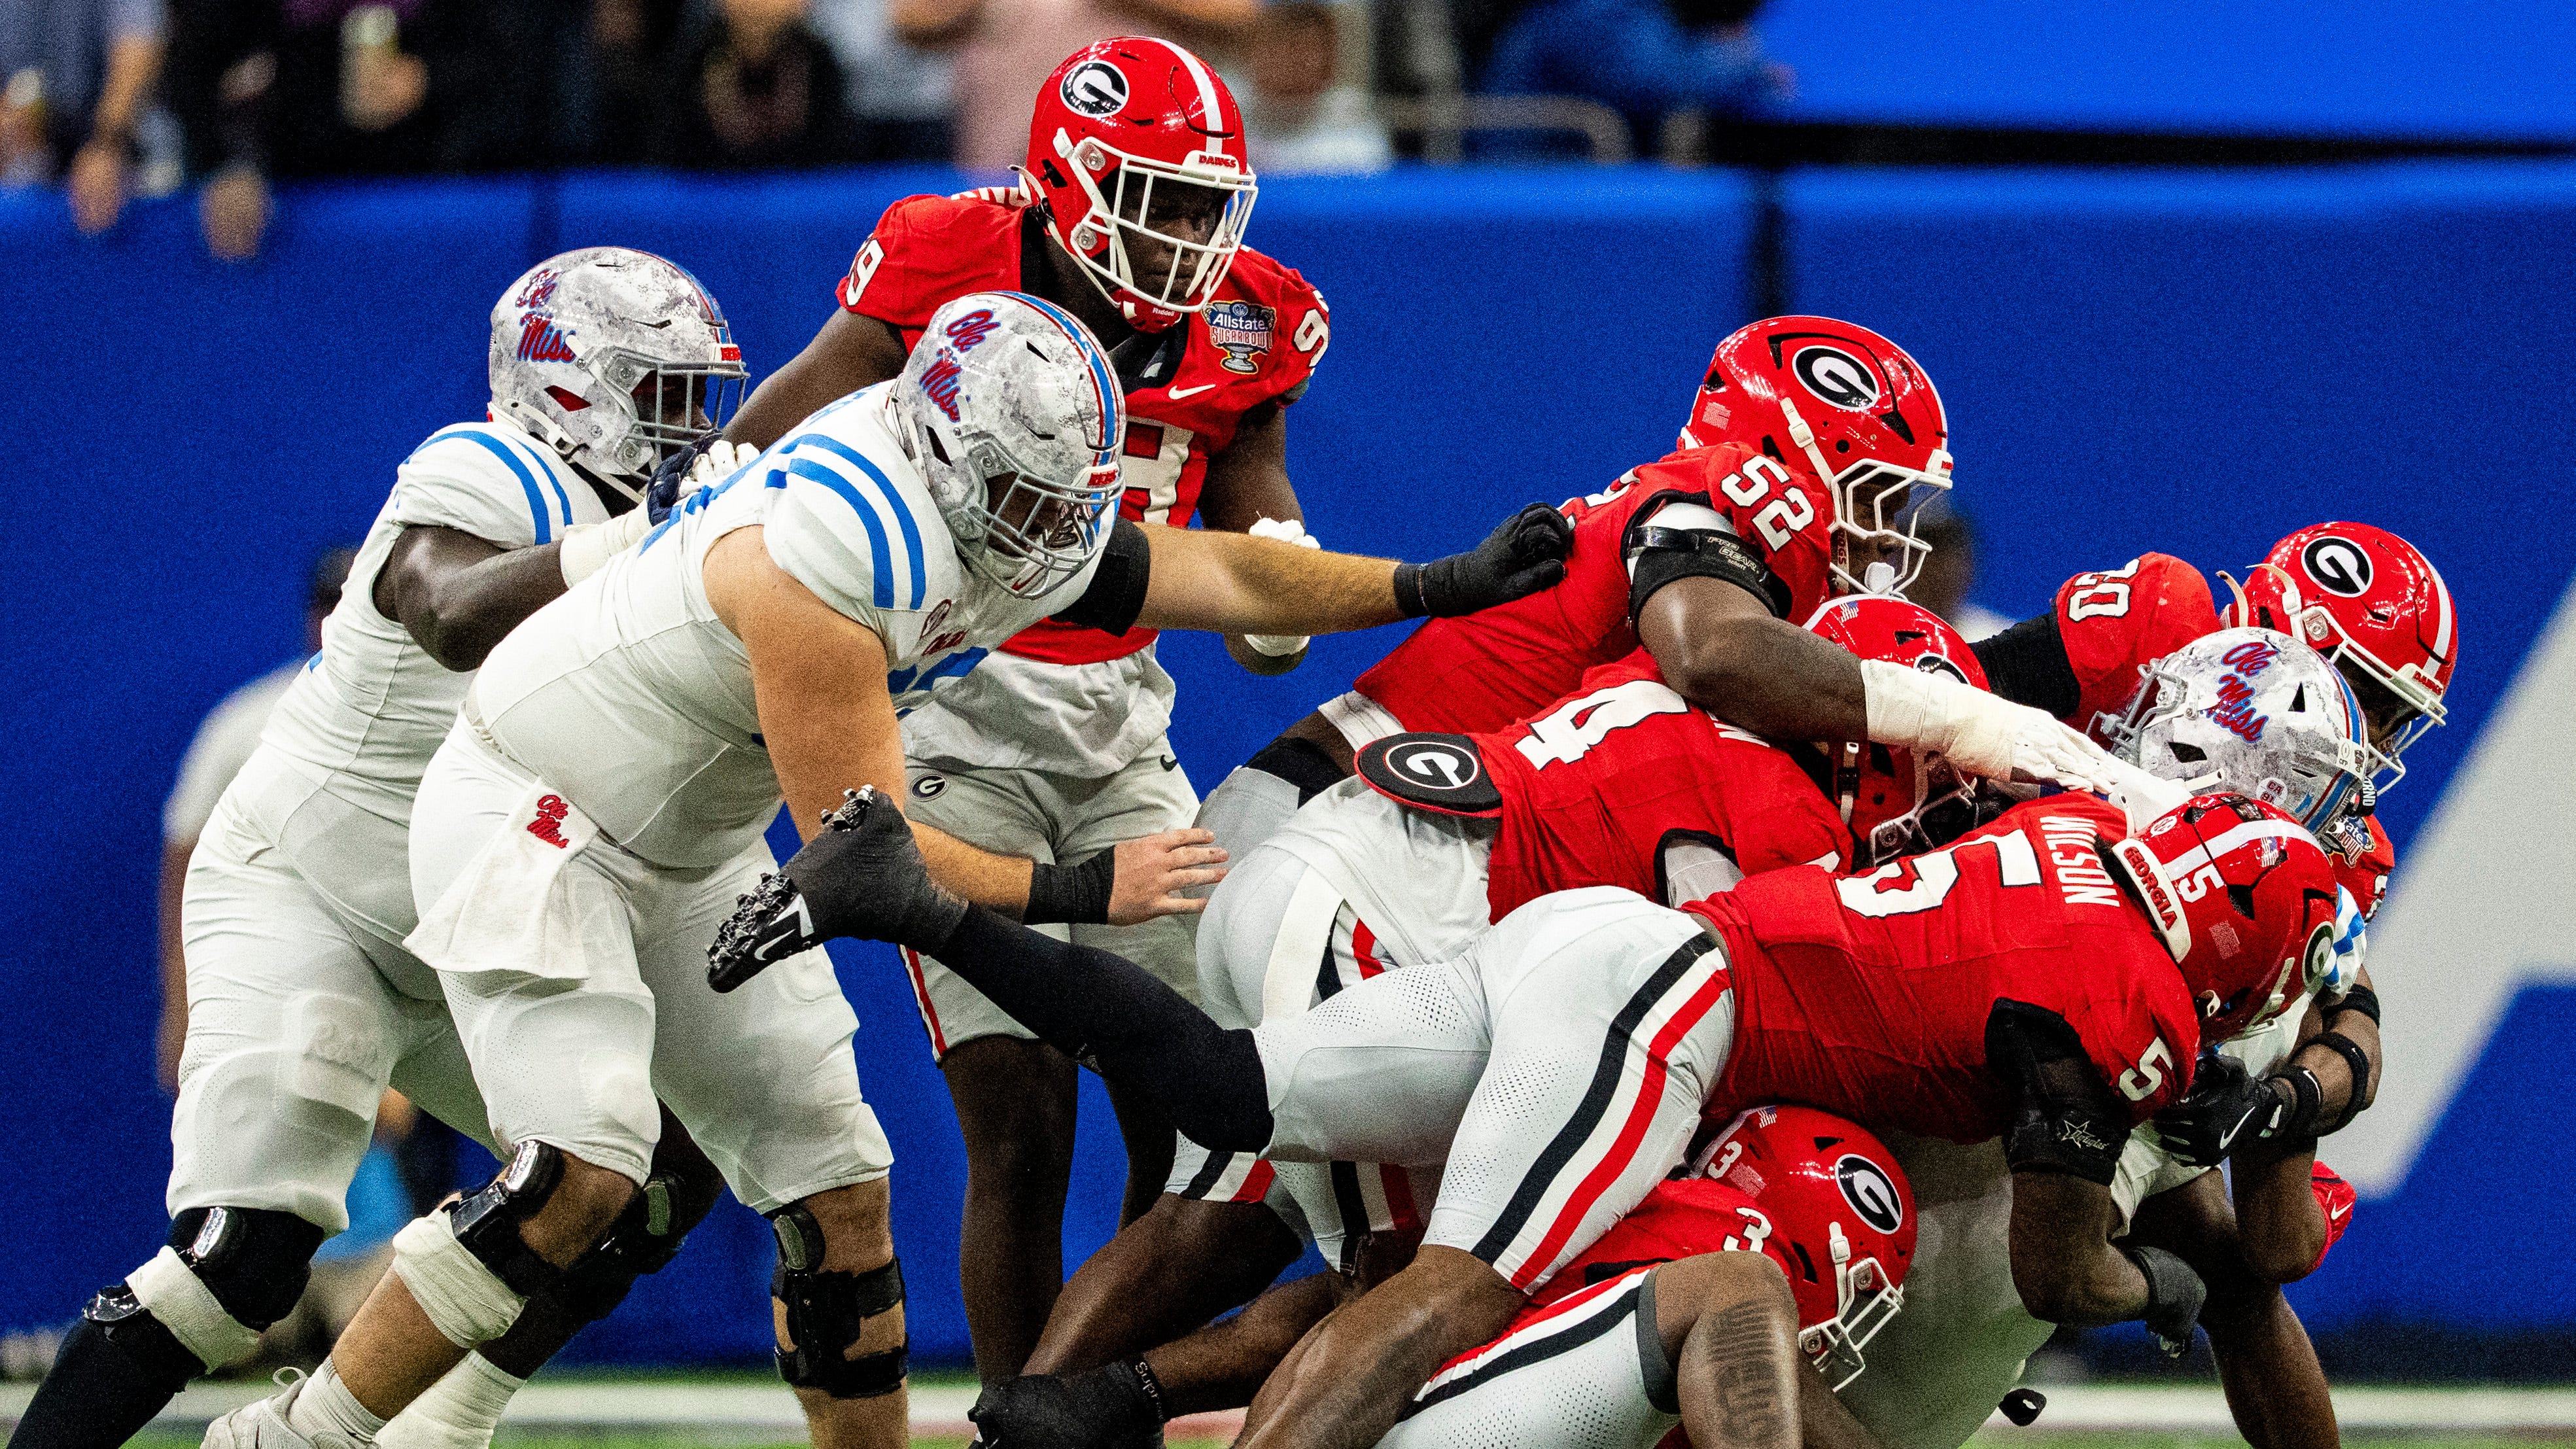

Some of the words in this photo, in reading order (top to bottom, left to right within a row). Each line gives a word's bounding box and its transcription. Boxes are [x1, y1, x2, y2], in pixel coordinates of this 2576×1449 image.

[1061, 61, 1128, 117] G
[1198, 154, 1236, 169] DAWGS
[846, 233, 884, 306] 9
[946, 309, 1001, 353] Ole
[1152, 306, 1175, 317] Riddell
[1212, 313, 1266, 331] Allstate
[1294, 290, 1329, 376] 9
[1792, 345, 1879, 411] G
[1721, 455, 1815, 551] 52
[1707, 536, 1739, 551] PRO
[1718, 546, 1757, 572] GEAR
[2302, 536, 2373, 597] G
[2221, 641, 2280, 678] Ole
[2201, 672, 2269, 744] Miss
[910, 774, 947, 799] G
[1386, 742, 1478, 789] G
[527, 810, 570, 849] Miss
[537, 794, 568, 820] Ole
[2340, 815, 2363, 843] tate
[1835, 828, 2044, 917] 5
[2040, 816, 2121, 907] WILSON
[2178, 862, 2225, 903] 5
[2123, 846, 2178, 931] GEORGIA
[2119, 1036, 2173, 1101] 5
[1707, 1140, 1743, 1179] 3
[1836, 1154, 1903, 1234] G
[1723, 1207, 1773, 1253] 3
[1135, 1361, 1164, 1420] Supr
